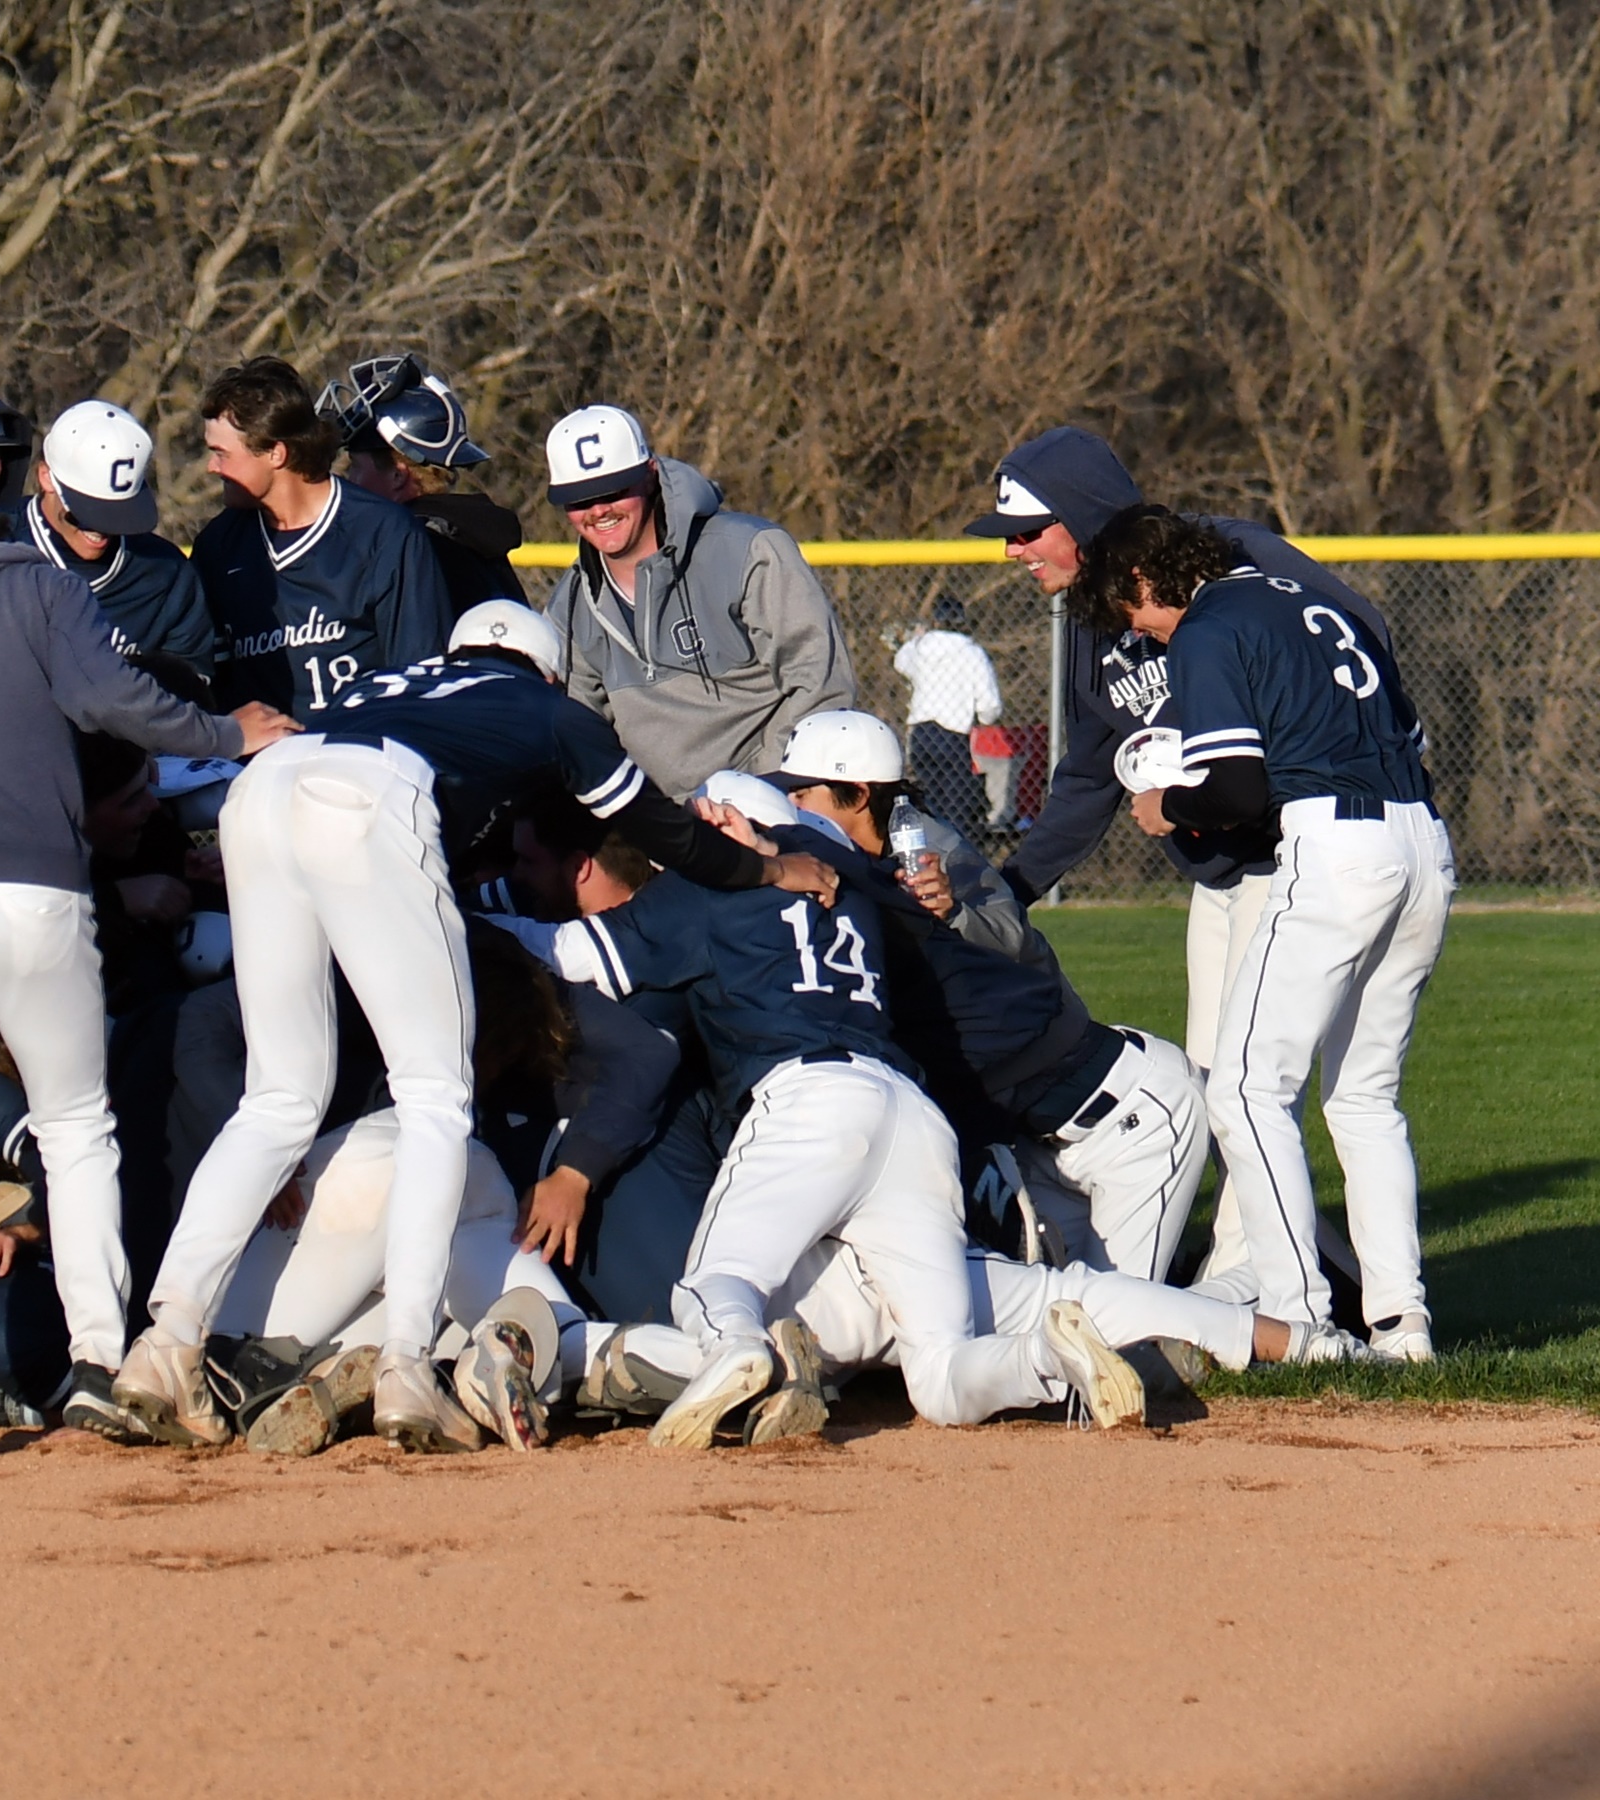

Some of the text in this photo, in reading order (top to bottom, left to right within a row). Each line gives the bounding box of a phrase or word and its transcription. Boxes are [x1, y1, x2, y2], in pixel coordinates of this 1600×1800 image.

[110, 456, 134, 493] C
[575, 433, 604, 471] C
[670, 615, 706, 660] C
[1302, 604, 1380, 700] 3
[780, 899, 882, 1012] 14
